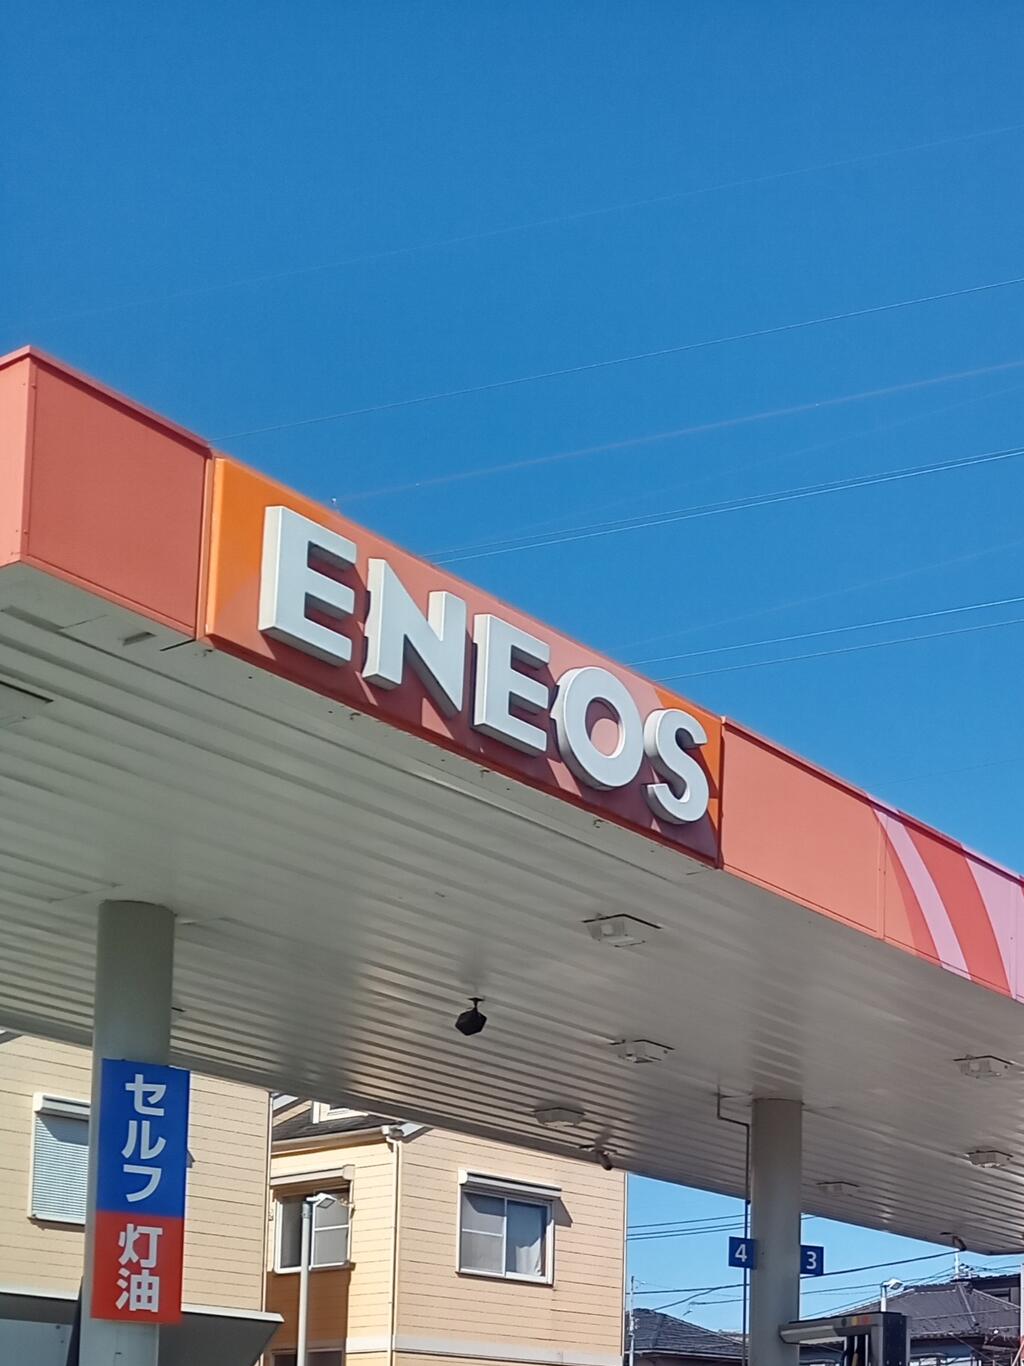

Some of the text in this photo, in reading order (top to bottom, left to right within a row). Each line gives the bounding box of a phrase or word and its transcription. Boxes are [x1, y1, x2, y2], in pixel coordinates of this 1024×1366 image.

[259, 505, 709, 824] ENEOS
[121, 1074, 167, 1202] セルフ
[115, 1223, 163, 1313] 灯油
[735, 1244, 747, 1262] 4
[806, 1251, 817, 1269] 3
